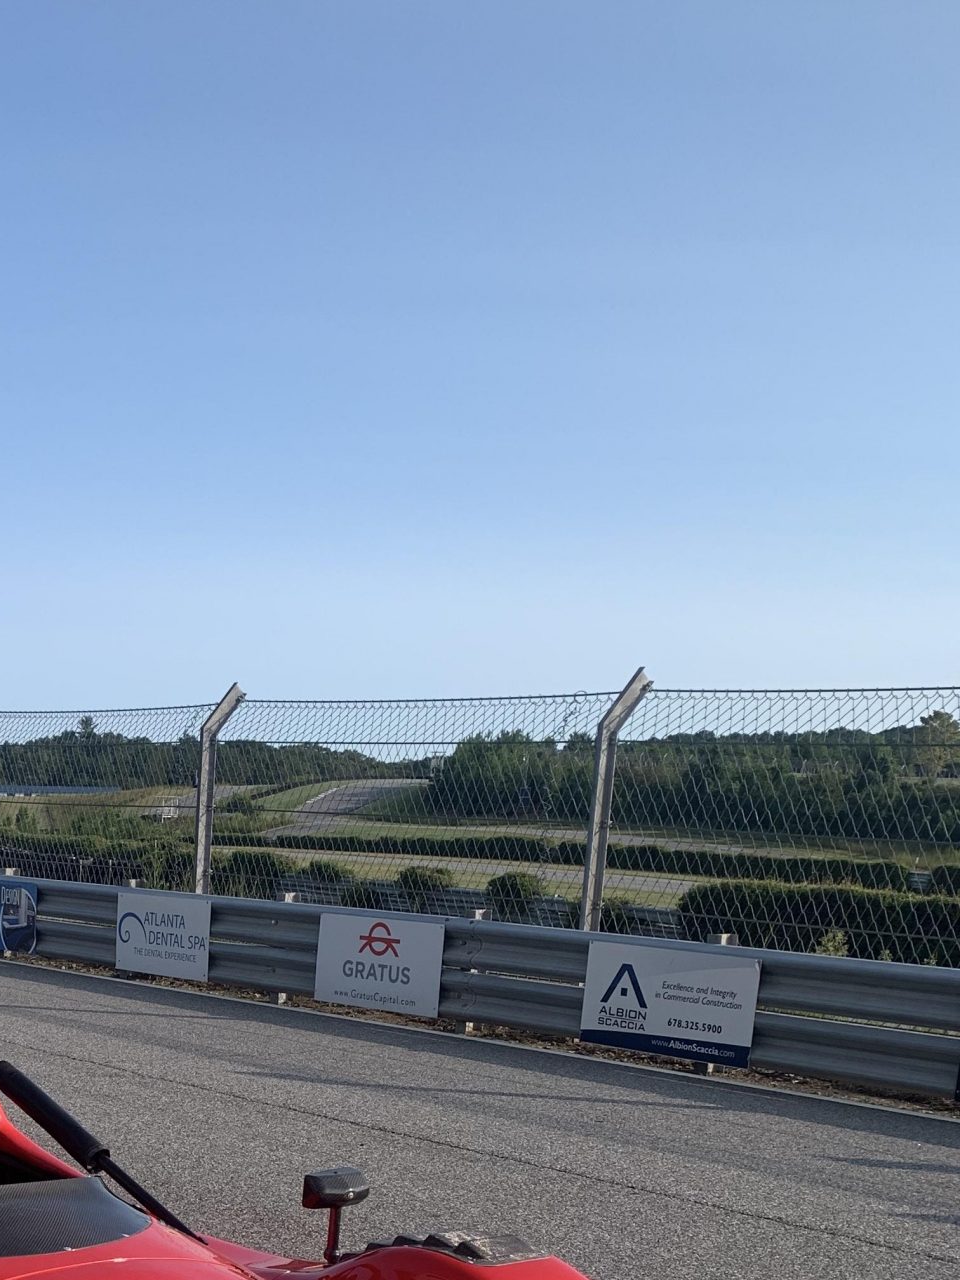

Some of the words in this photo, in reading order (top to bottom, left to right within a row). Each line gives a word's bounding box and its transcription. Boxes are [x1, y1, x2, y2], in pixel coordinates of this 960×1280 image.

[143, 911, 186, 929] ATLANTA
[148, 930, 185, 949] DENTAL
[187, 935, 206, 951] SPA
[134, 946, 143, 956] THE
[144, 948, 163, 959] DENTAL
[165, 951, 197, 963] EXPERIENCE
[342, 960, 411, 985] GRATUS
[334, 989, 416, 1007] www.GratusCapital.com
[661, 980, 694, 993] Excellence
[695, 986, 709, 995] and
[710, 987, 738, 1000] Integrity
[655, 991, 661, 999] in
[662, 991, 700, 1004] Commercial
[701, 997, 742, 1010] Construction
[599, 1005, 647, 1021] ALBION
[597, 1017, 646, 1032] SCACCIA
[667, 1017, 722, 1034] 678.325.5900
[651, 1038, 735, 1058] www.AlbionScaccia.com
